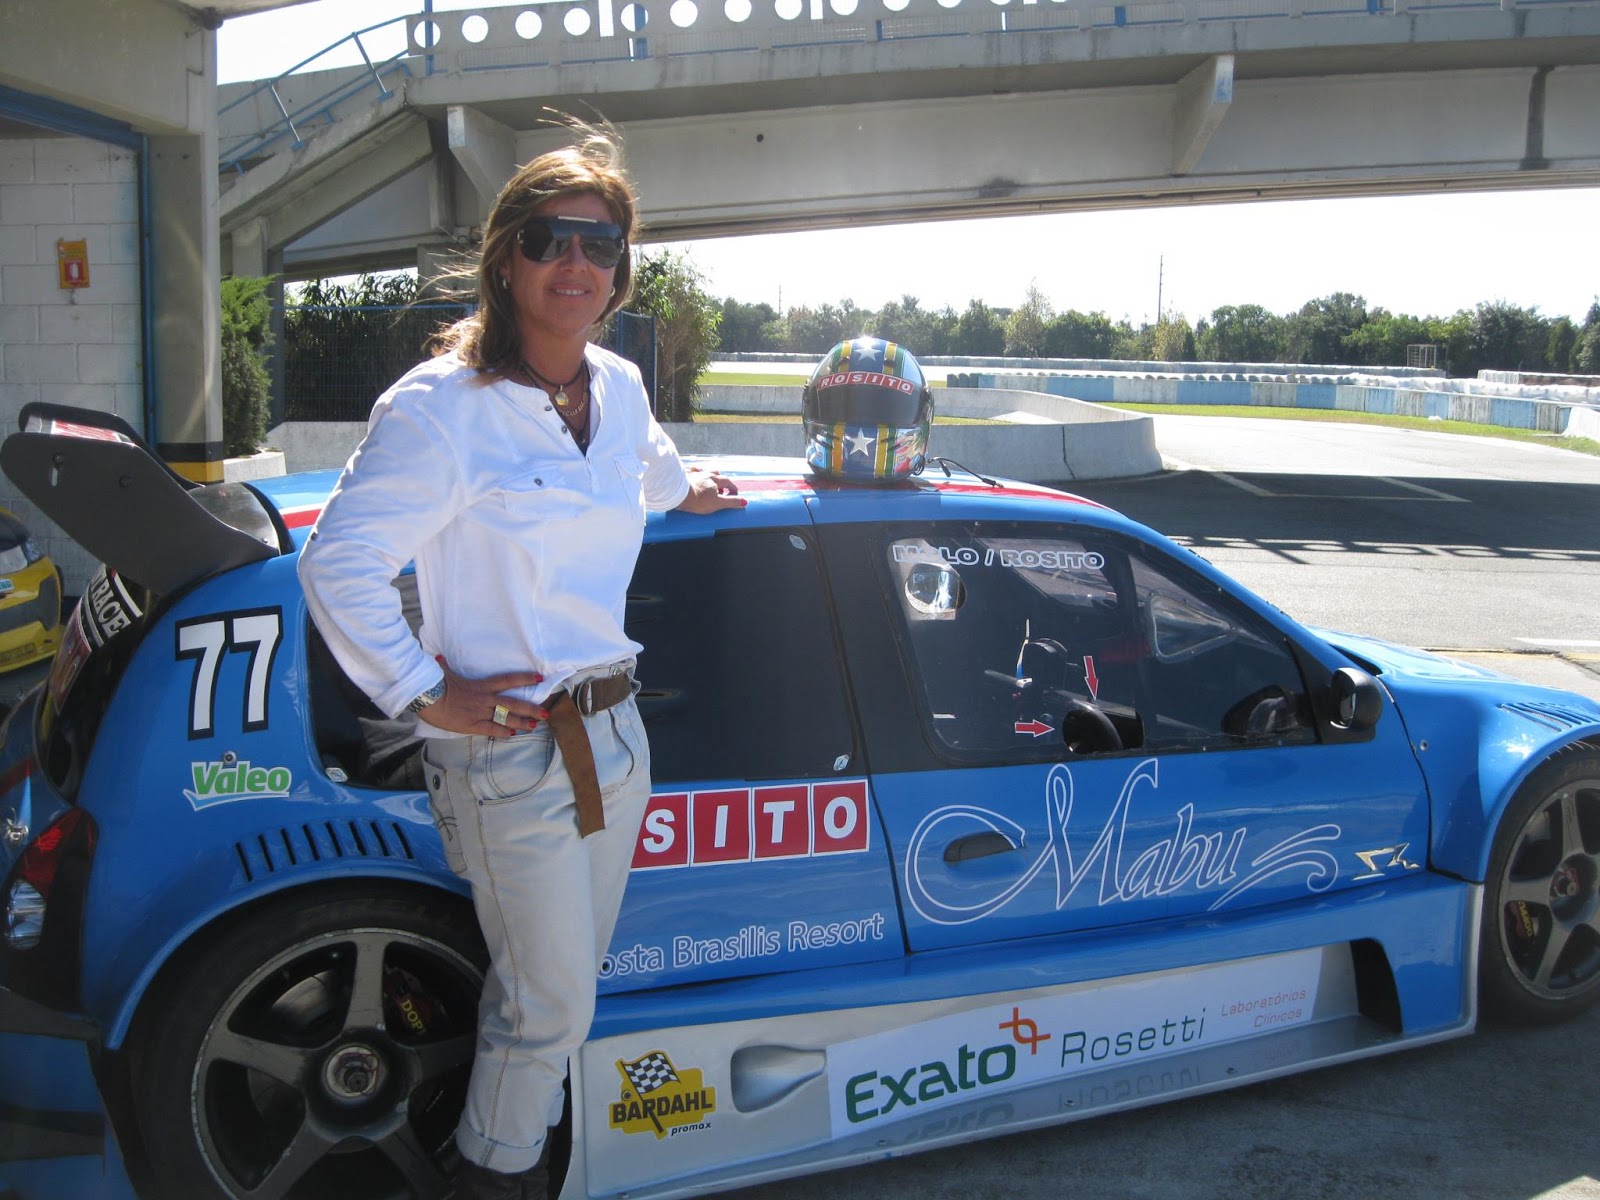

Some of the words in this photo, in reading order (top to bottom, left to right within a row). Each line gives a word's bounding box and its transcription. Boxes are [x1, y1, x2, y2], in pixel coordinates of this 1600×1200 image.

[820, 372, 909, 391] ROSITO
[1000, 549, 1105, 569] ROSITO
[175, 605, 284, 740] 77
[192, 761, 292, 796] Valeo
[905, 758, 1247, 924] Mabu
[673, 926, 780, 968] Brasilis
[788, 913, 884, 951] Resort
[845, 1044, 1016, 1124] Exato
[1061, 1007, 1206, 1068] Rosetti
[613, 1090, 713, 1123] BARDAHL
[671, 1121, 712, 1136] promax
